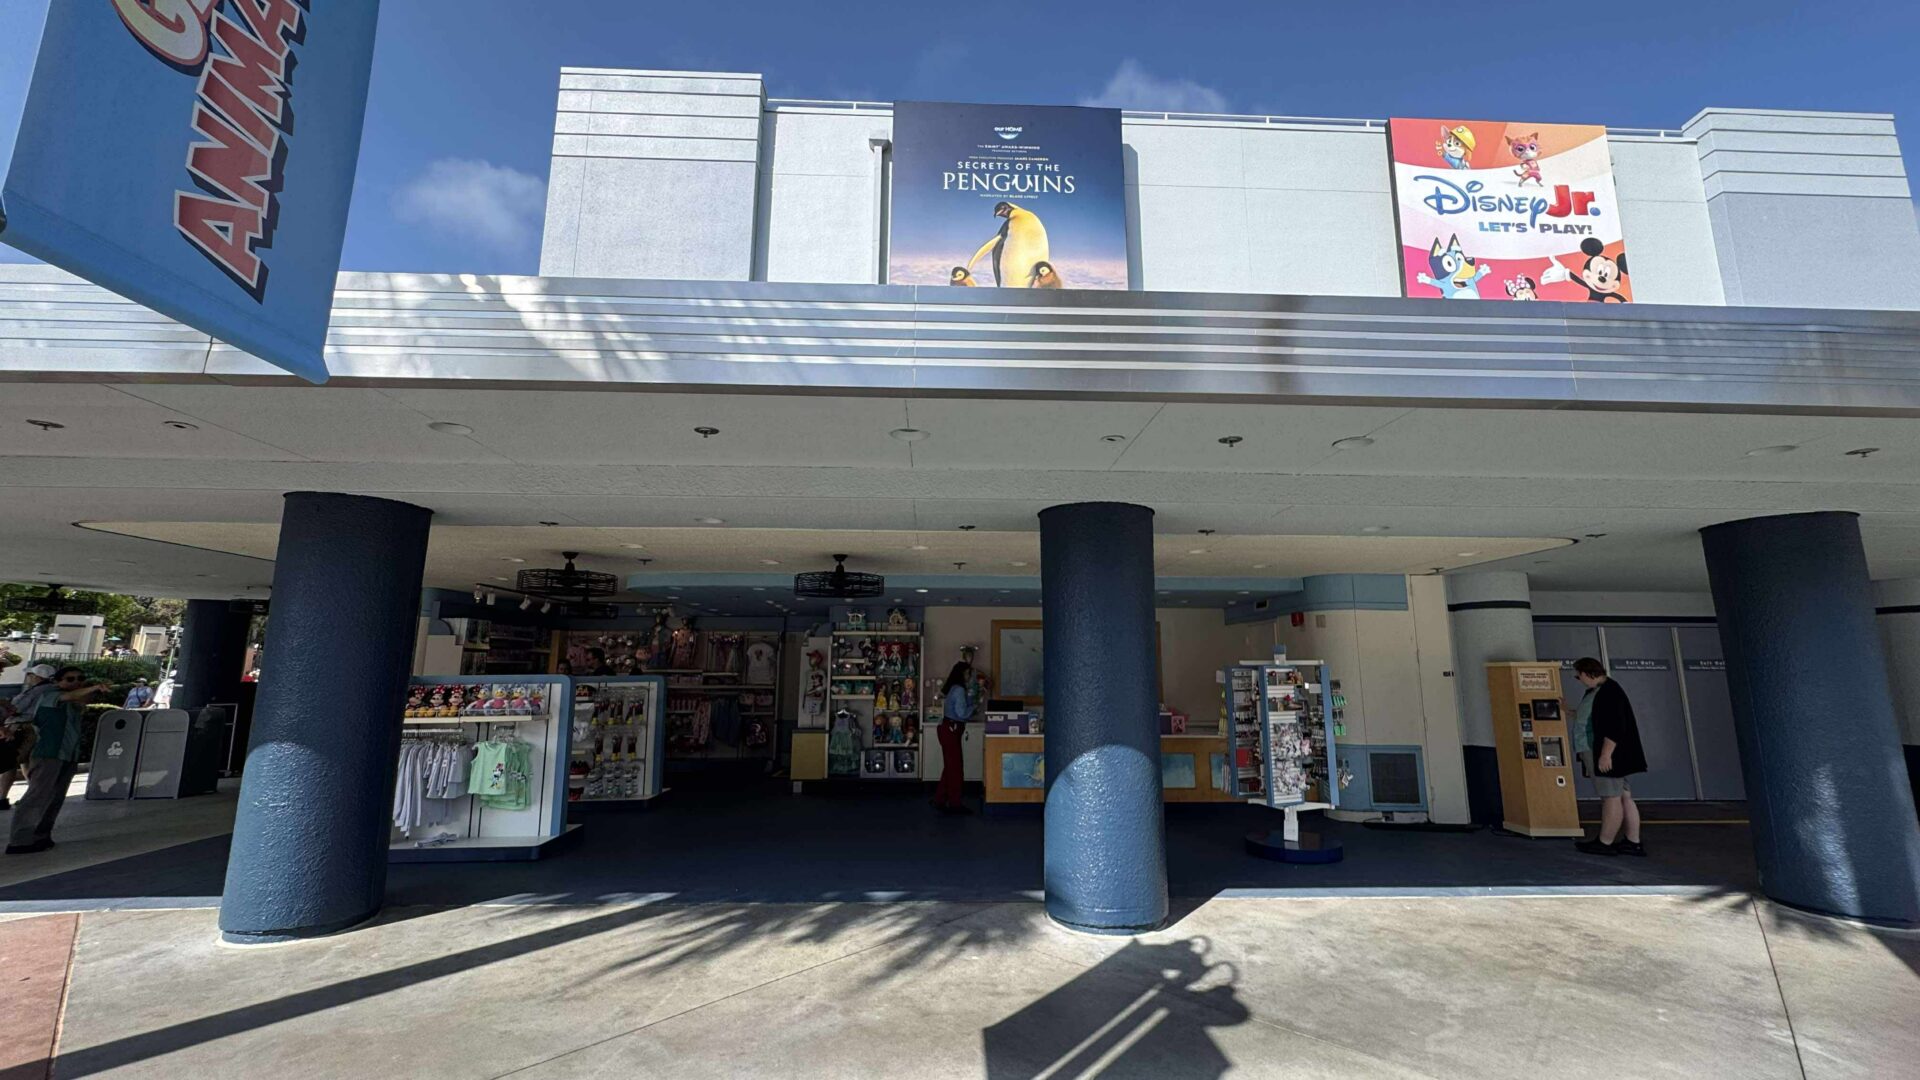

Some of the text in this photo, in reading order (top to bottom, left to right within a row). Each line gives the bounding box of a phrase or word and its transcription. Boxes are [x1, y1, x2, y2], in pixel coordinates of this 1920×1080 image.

[957, 161, 1060, 172] SECRETS OF THE
[943, 172, 1076, 194] PENGUINS
[1546, 184, 1601, 218] Jr.
[1478, 221, 1593, 235] LET'S PLAY!
